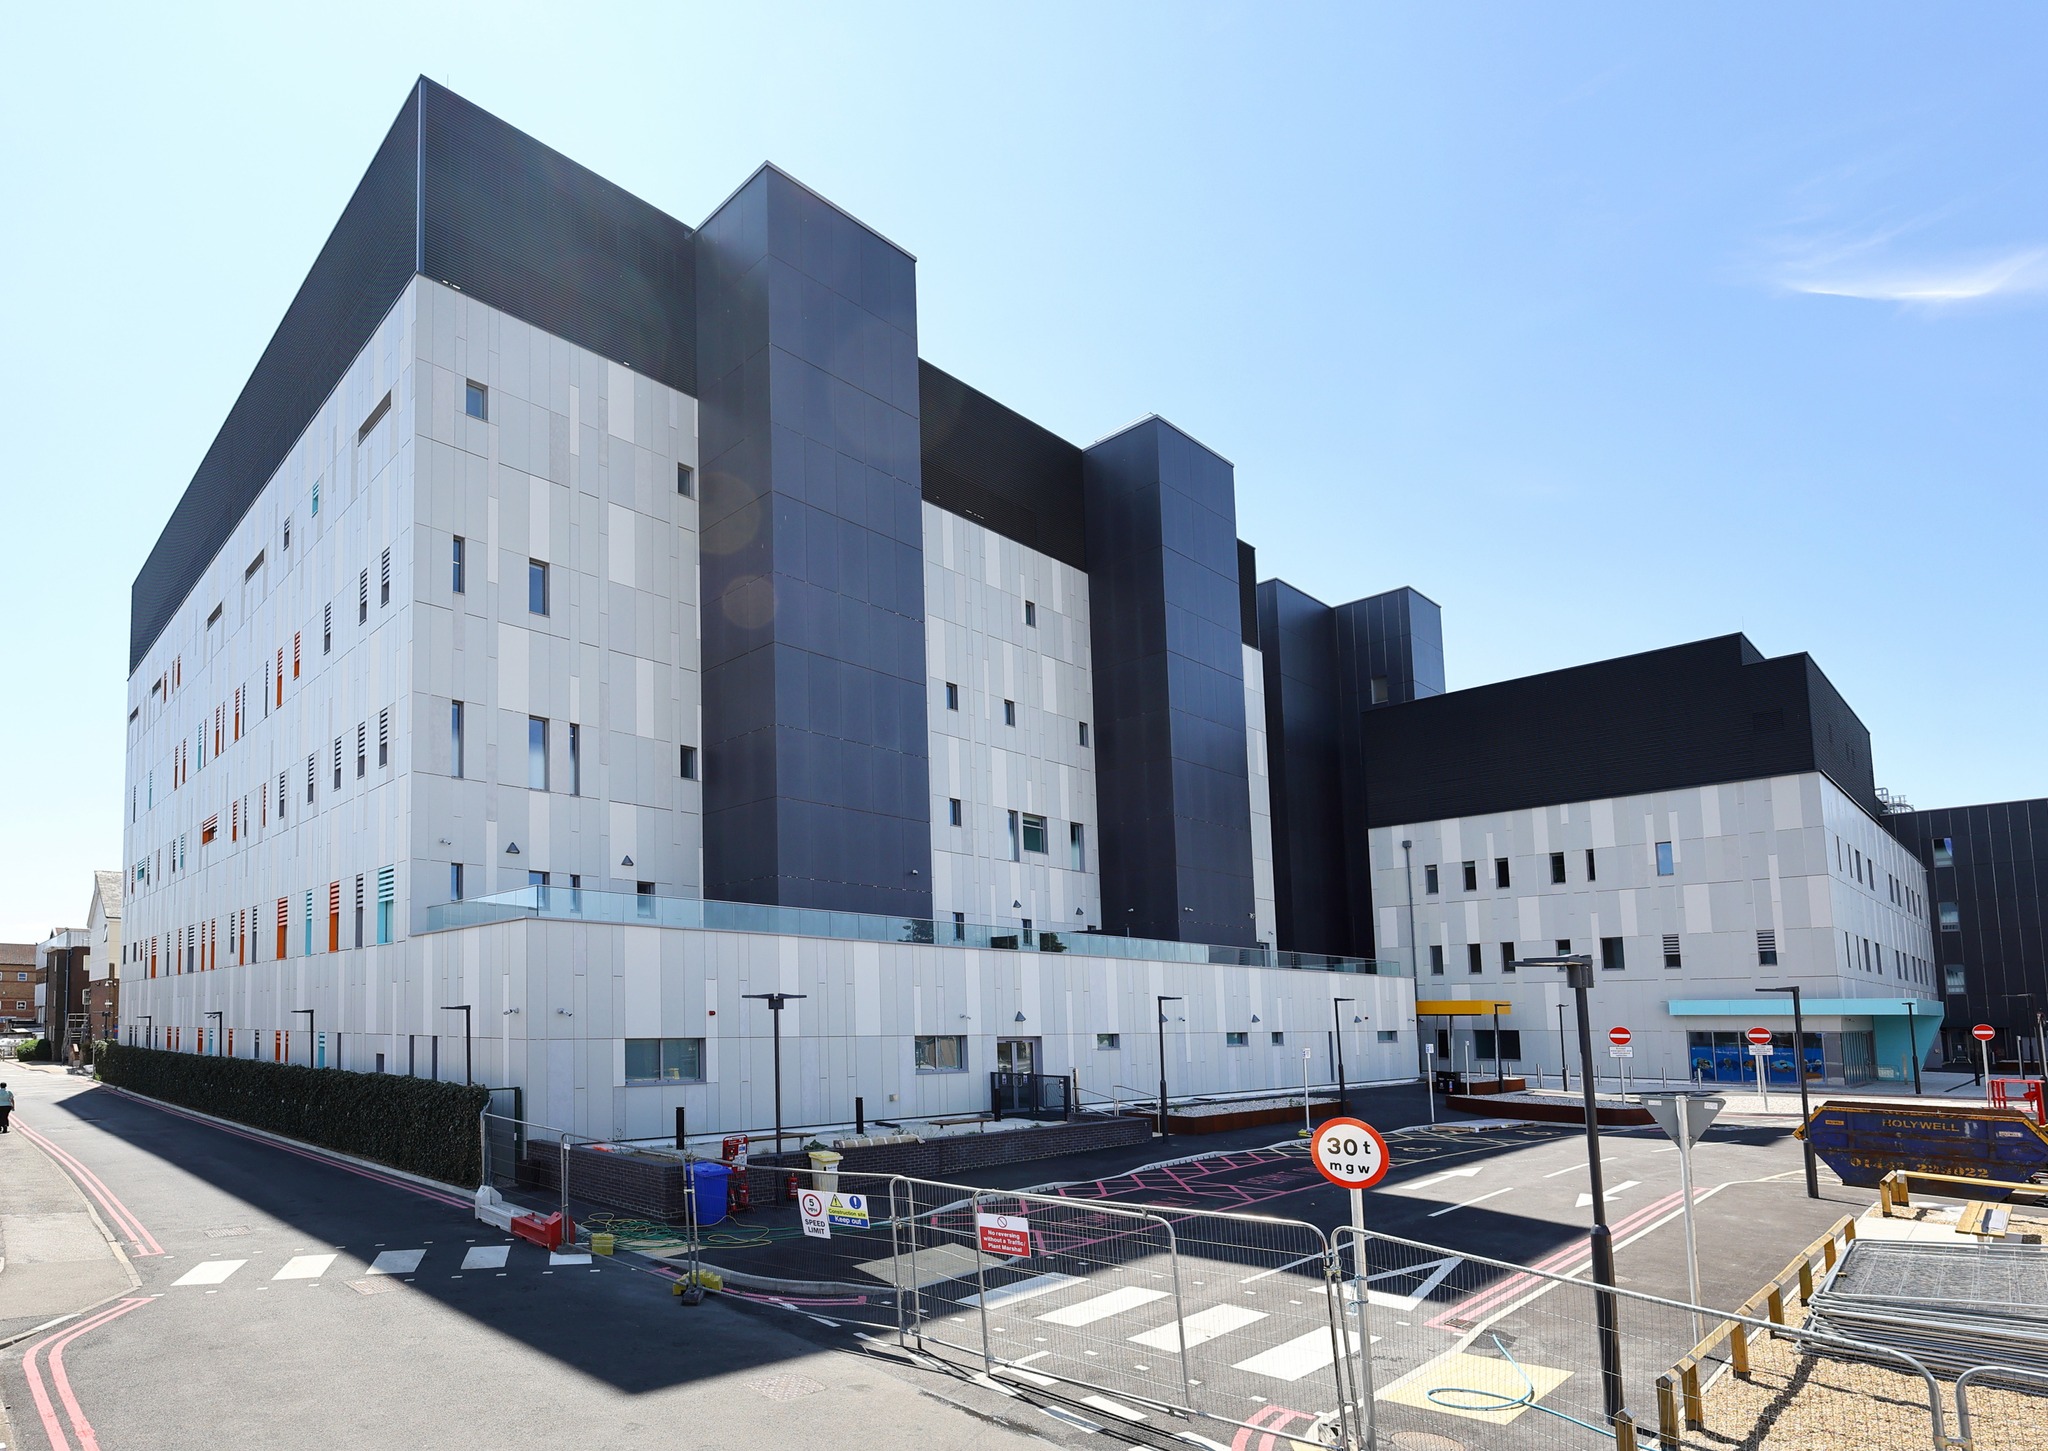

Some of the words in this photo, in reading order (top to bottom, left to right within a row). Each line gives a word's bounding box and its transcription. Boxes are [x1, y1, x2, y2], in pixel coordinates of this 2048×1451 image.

[1882, 1119, 1960, 1132] HOLYWELL
[1326, 1137, 1358, 1156] 30
[808, 1199, 815, 1207] 5
[828, 1208, 857, 1216] Construction
[804, 1219, 825, 1227] SPEED
[834, 1216, 851, 1224] Keep
[808, 1227, 825, 1235] LIMIT
[996, 1231, 1020, 1240] reversing
